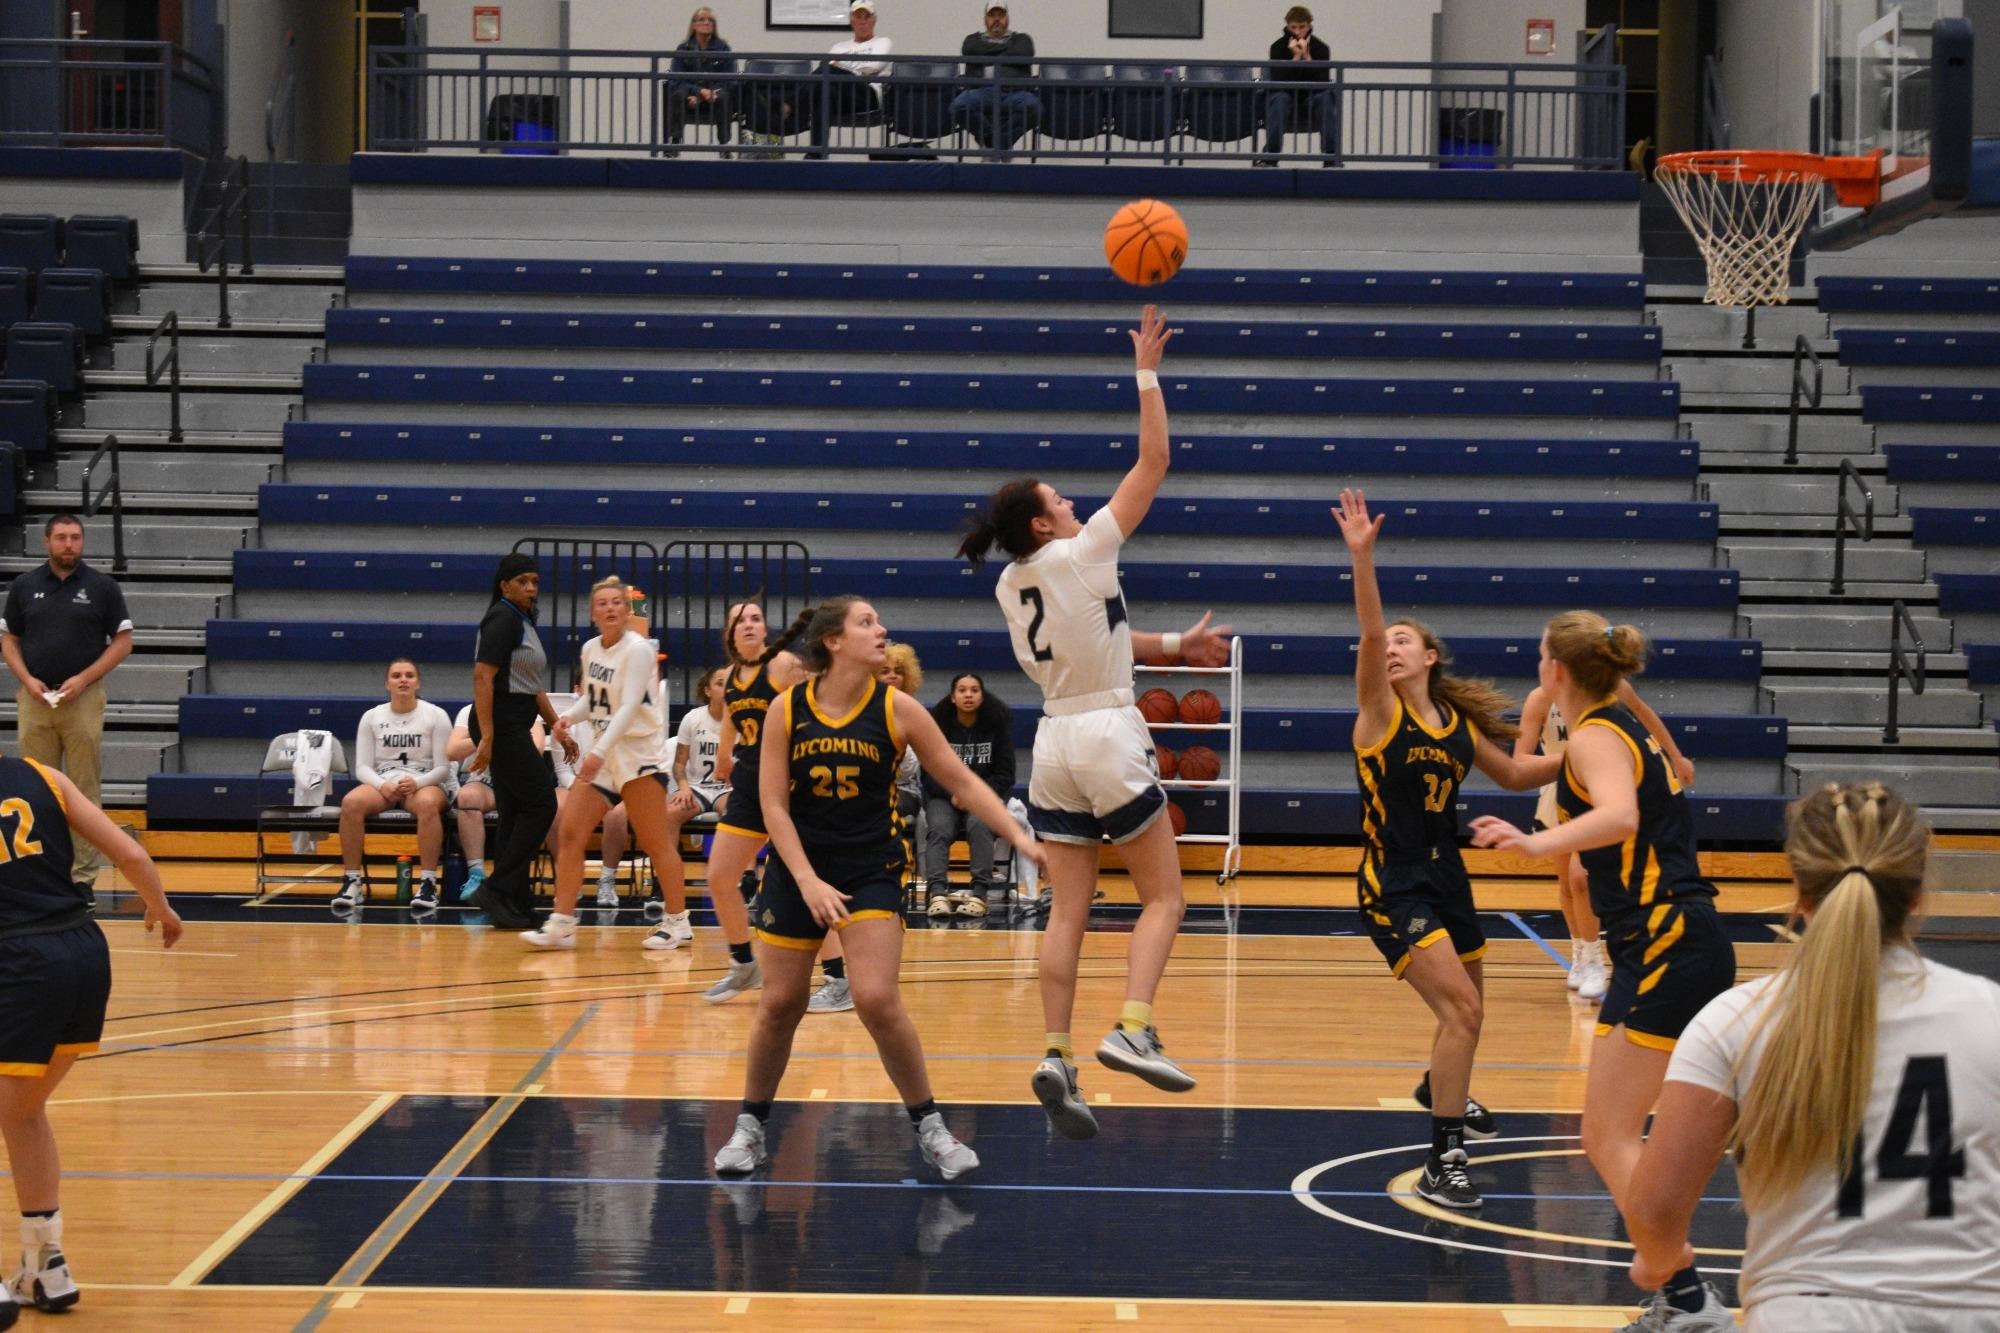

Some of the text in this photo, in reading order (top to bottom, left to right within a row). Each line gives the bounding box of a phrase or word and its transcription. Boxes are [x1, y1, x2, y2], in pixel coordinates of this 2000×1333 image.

[1019, 586, 1053, 662] 2
[383, 734, 422, 748] MOUNT
[792, 737, 880, 763] LYCOMING
[397, 752, 408, 765] 4
[809, 765, 860, 800] 25
